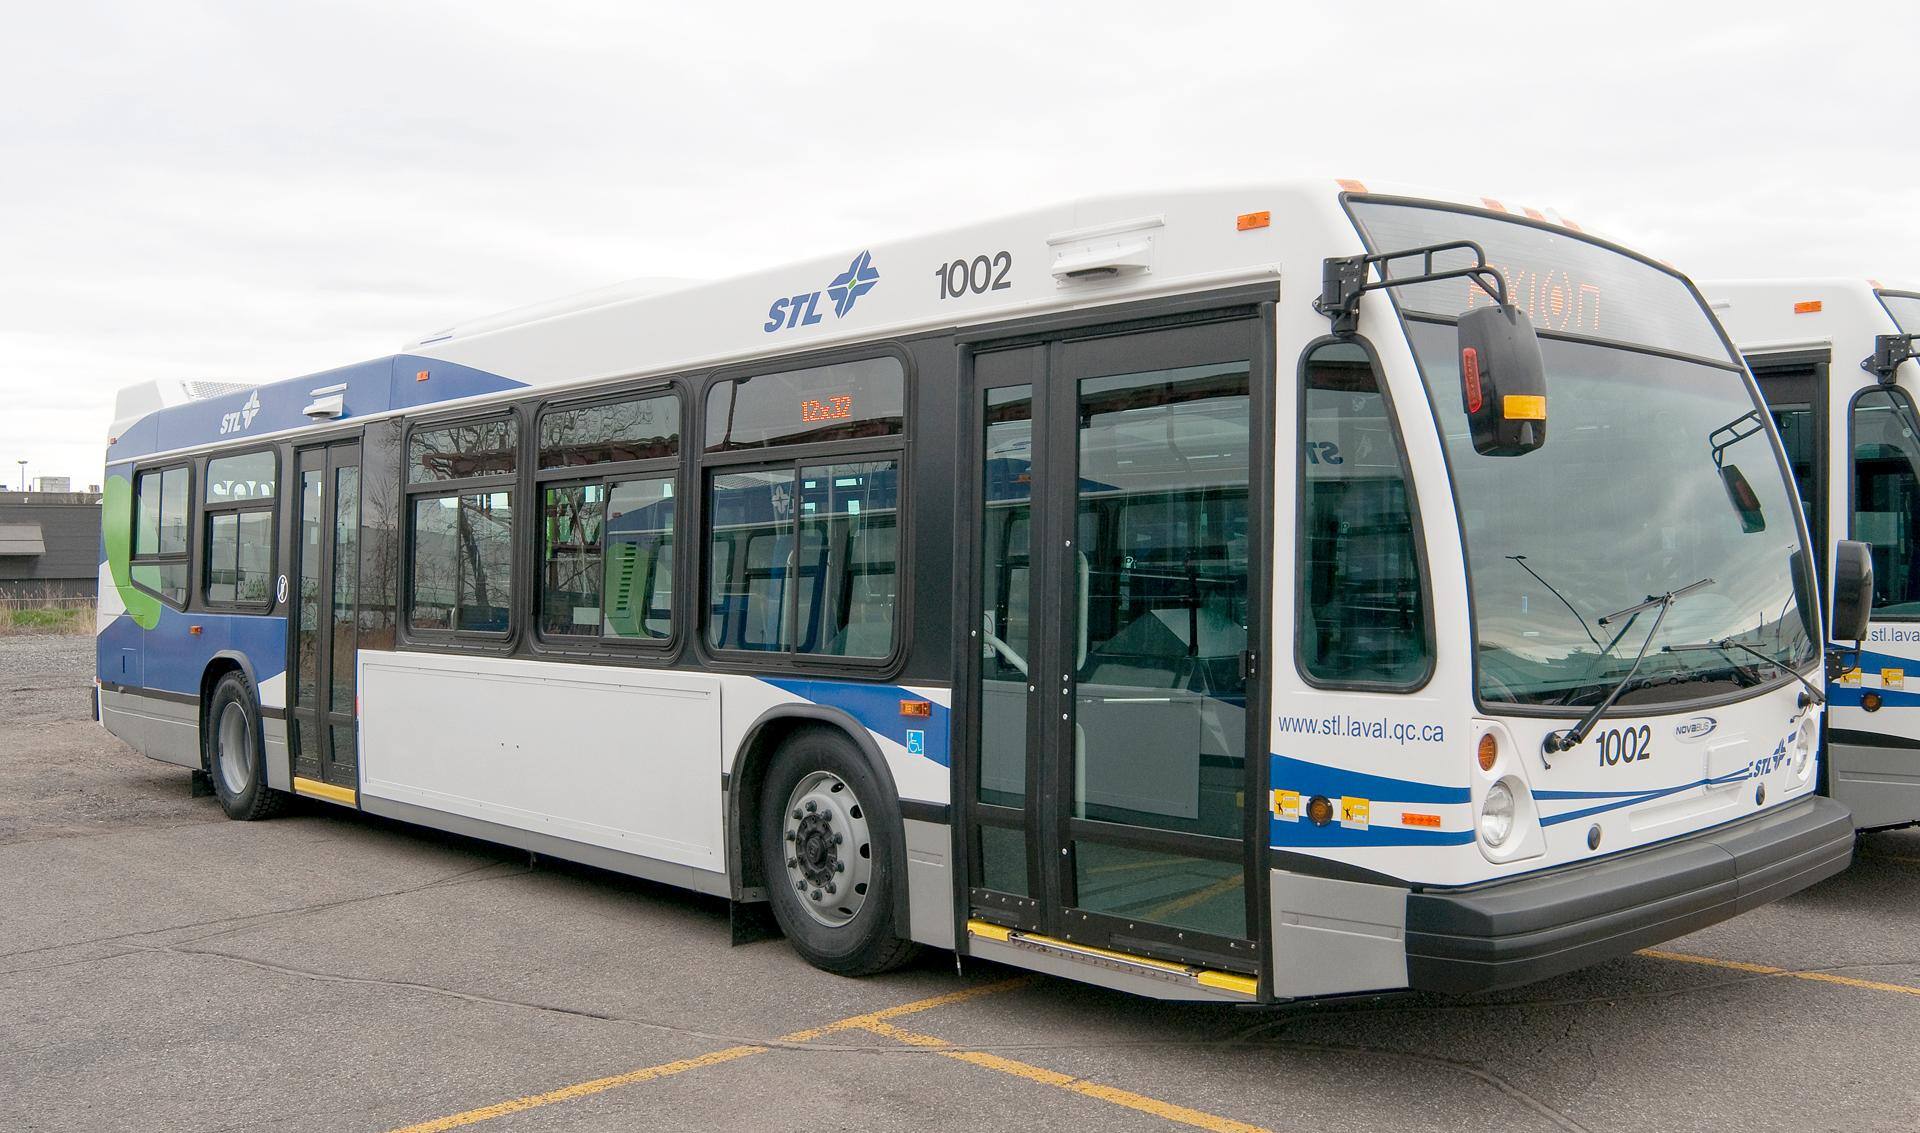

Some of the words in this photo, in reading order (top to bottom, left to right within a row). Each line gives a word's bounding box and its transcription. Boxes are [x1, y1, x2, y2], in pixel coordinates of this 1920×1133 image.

[935, 250, 1012, 300] 1002
[763, 290, 825, 334] STL
[219, 411, 241, 435] STL
[1278, 714, 1444, 746] www.stl.laval.qc.ca
[1595, 724, 1651, 767] 1002
[1753, 757, 1772, 778] STL
